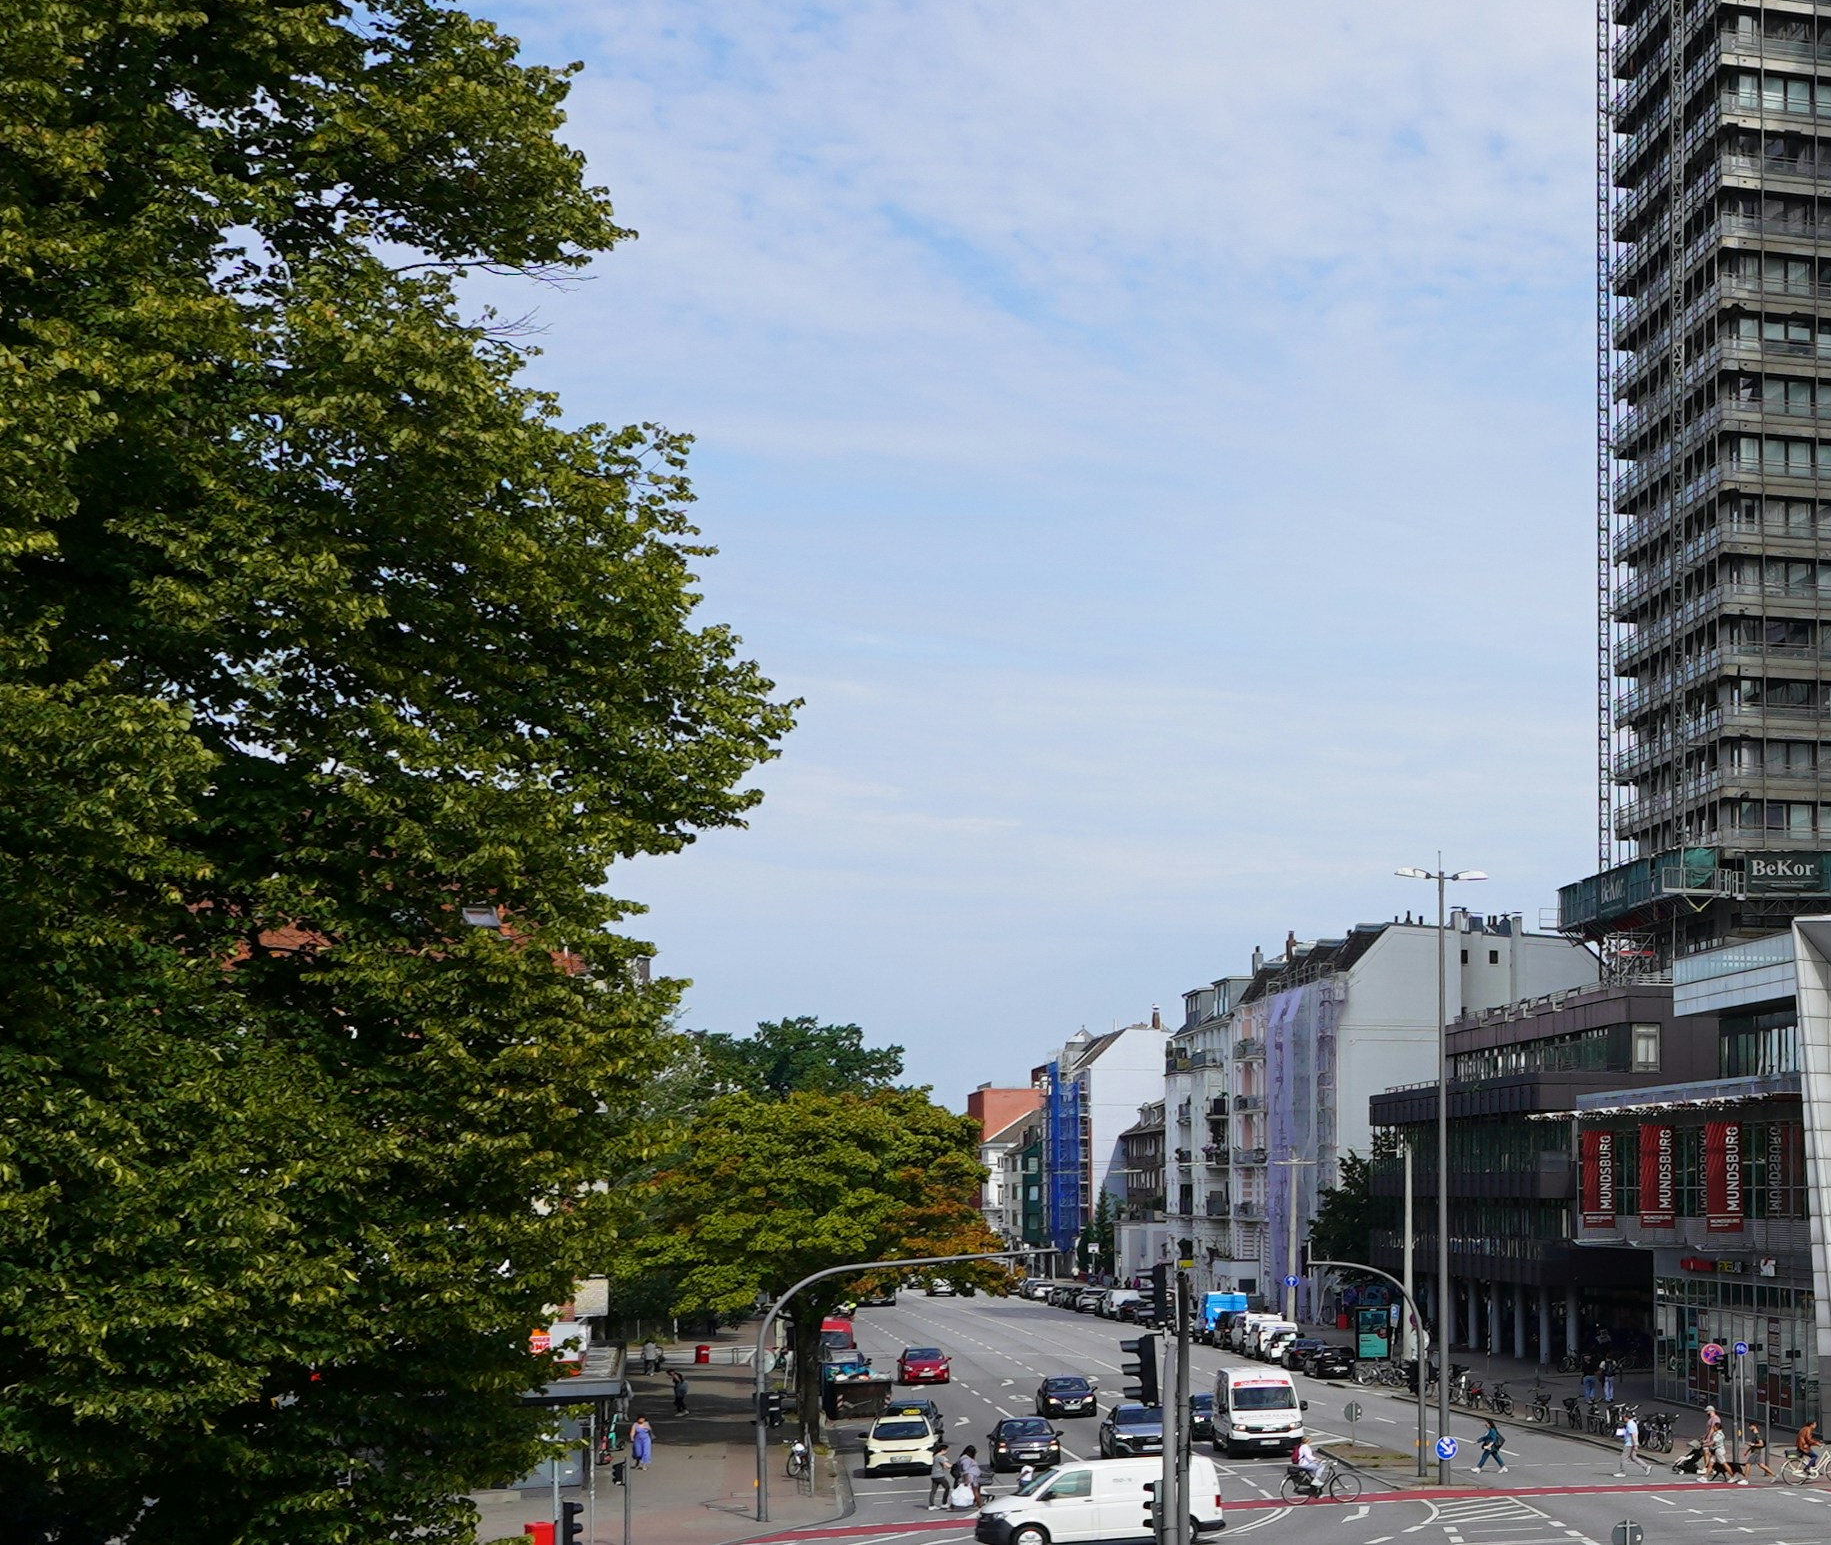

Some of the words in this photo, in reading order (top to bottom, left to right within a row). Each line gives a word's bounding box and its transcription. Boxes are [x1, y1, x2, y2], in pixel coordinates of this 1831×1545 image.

[1751, 859, 1815, 876] BeKor
[1600, 1135, 1612, 1209] MUNDSBURG
[1659, 1129, 1672, 1208] MUNDSBURG
[1726, 1126, 1740, 1211] MUNDSBURG
